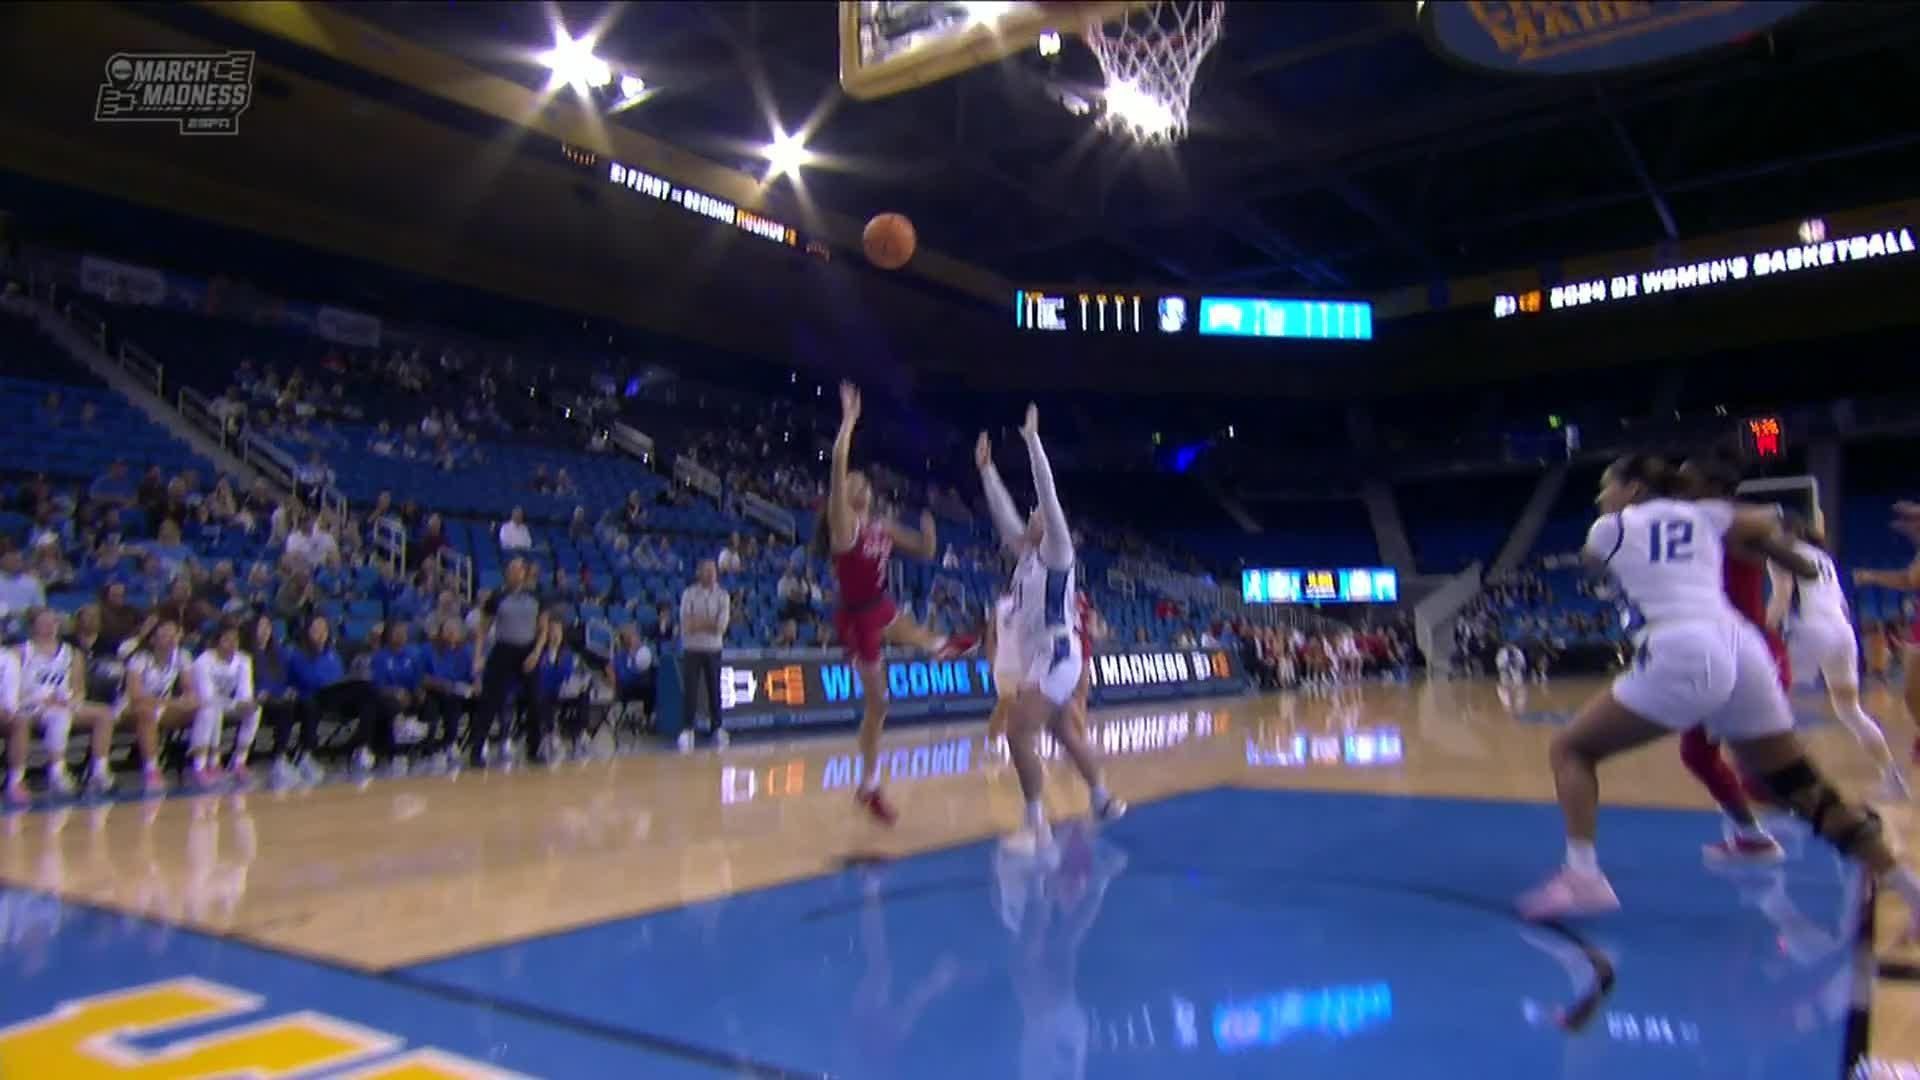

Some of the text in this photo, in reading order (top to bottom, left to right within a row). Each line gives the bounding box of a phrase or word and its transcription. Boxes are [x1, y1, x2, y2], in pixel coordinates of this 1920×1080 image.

[1642, 256, 1748, 294] WOMEN'S
[1753, 229, 1915, 276] BASKETBALL
[1650, 519, 1694, 562] 12
[820, 657, 971, 701] WCOME
[1100, 653, 1188, 686] MADNESS
